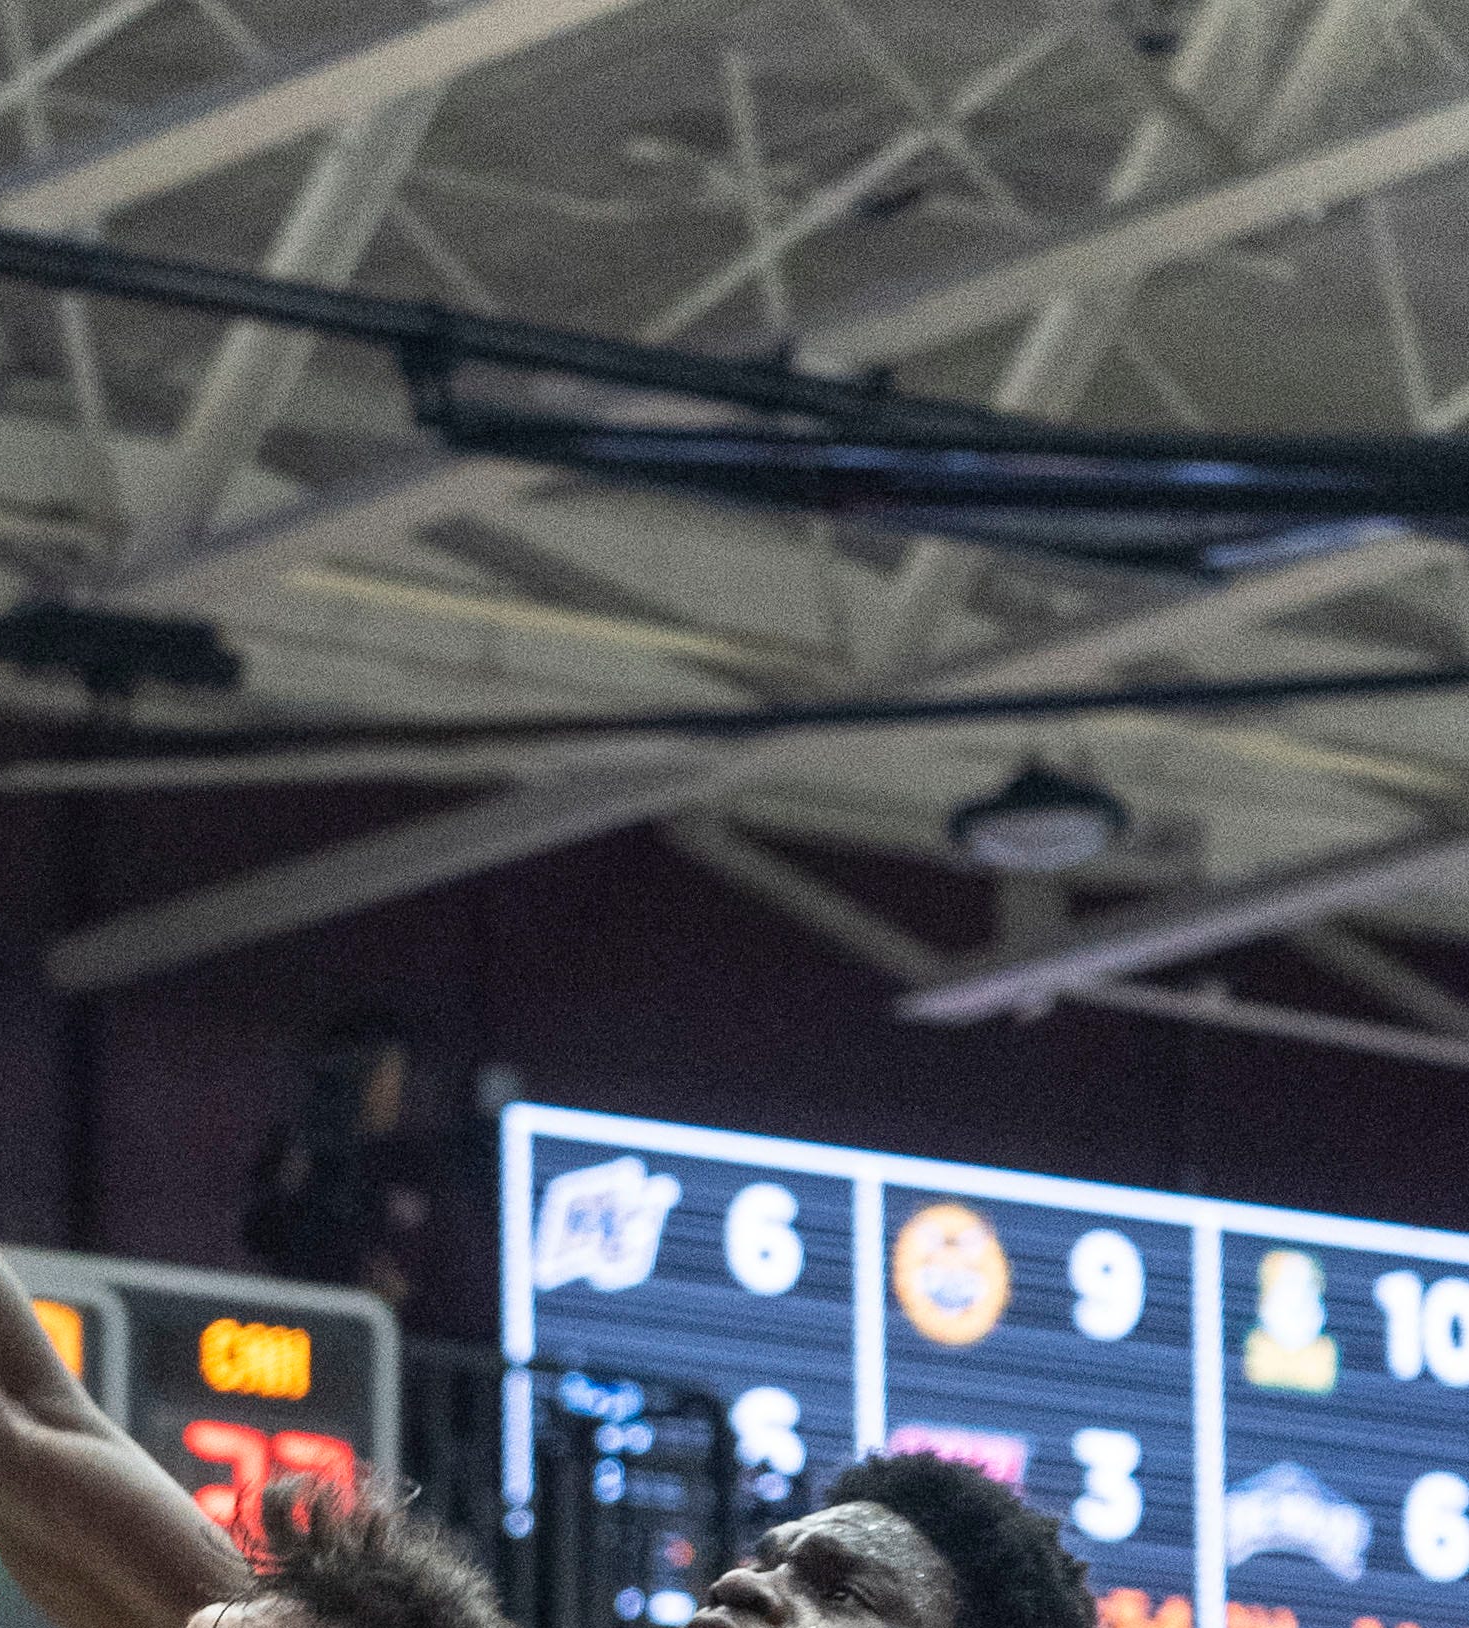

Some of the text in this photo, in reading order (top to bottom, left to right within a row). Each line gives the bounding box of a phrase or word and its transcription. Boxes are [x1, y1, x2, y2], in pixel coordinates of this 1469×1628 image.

[724, 1182, 805, 1297] 6
[1068, 1229, 1145, 1342] 9
[1373, 1270, 1469, 1388] 10
[1071, 1427, 1143, 1542] 3
[1402, 1470, 1469, 1583] 6
